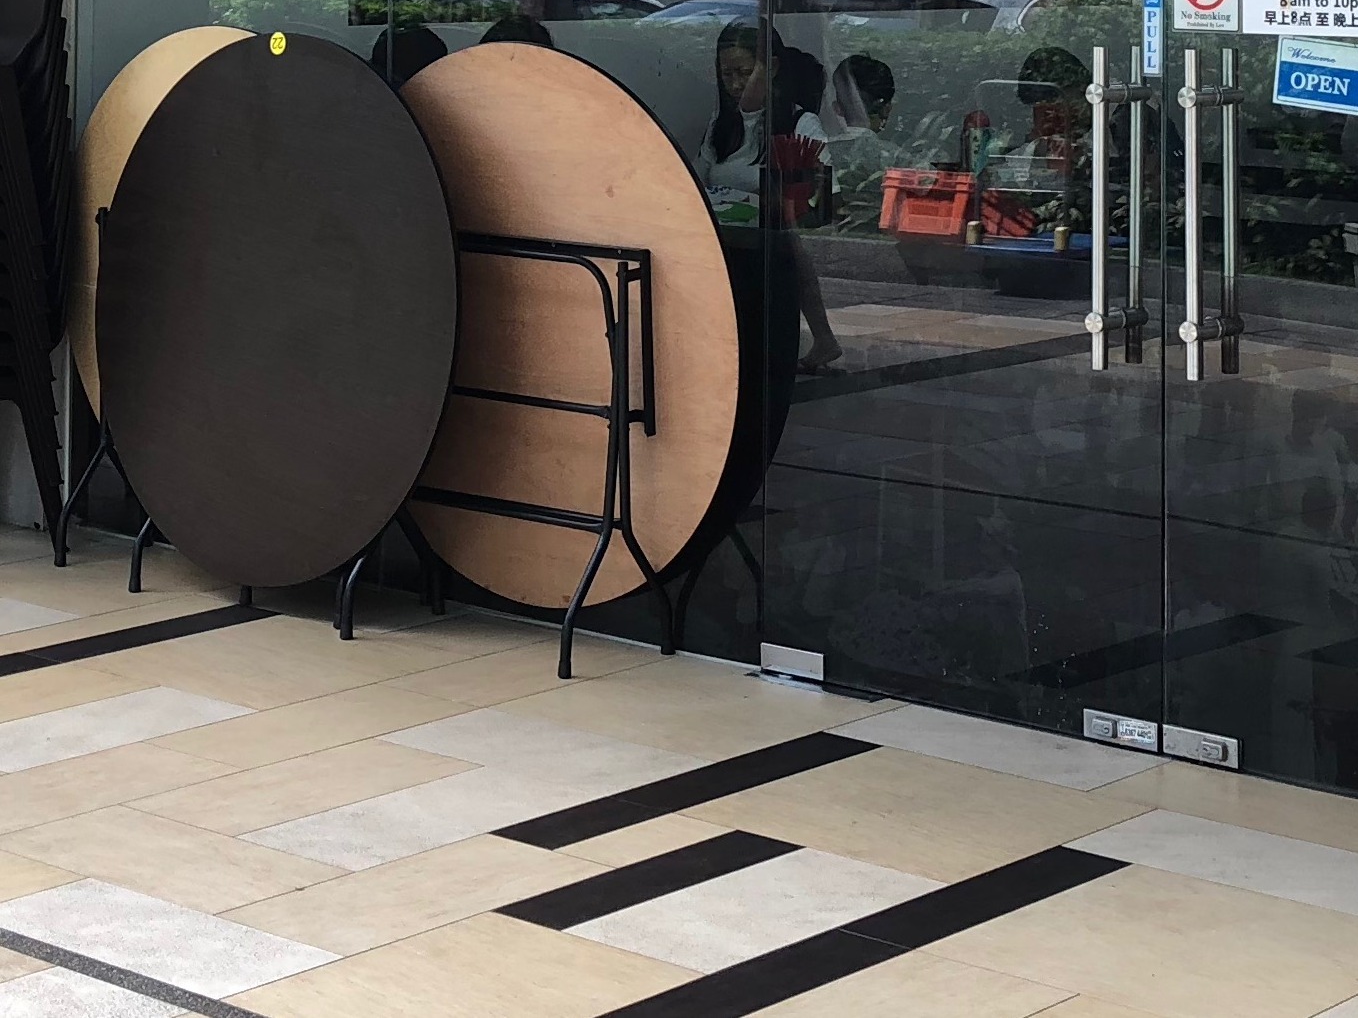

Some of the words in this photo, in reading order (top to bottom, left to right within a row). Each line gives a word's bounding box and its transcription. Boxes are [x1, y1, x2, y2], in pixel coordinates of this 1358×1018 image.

[1181, 11, 1192, 20] No
[1194, 11, 1231, 22] Smoking
[1316, 12, 1329, 27] 至
[1147, 10, 1157, 69] PULL
[1288, 46, 1336, 63] Welcome
[1290, 72, 1350, 96] OPEN
